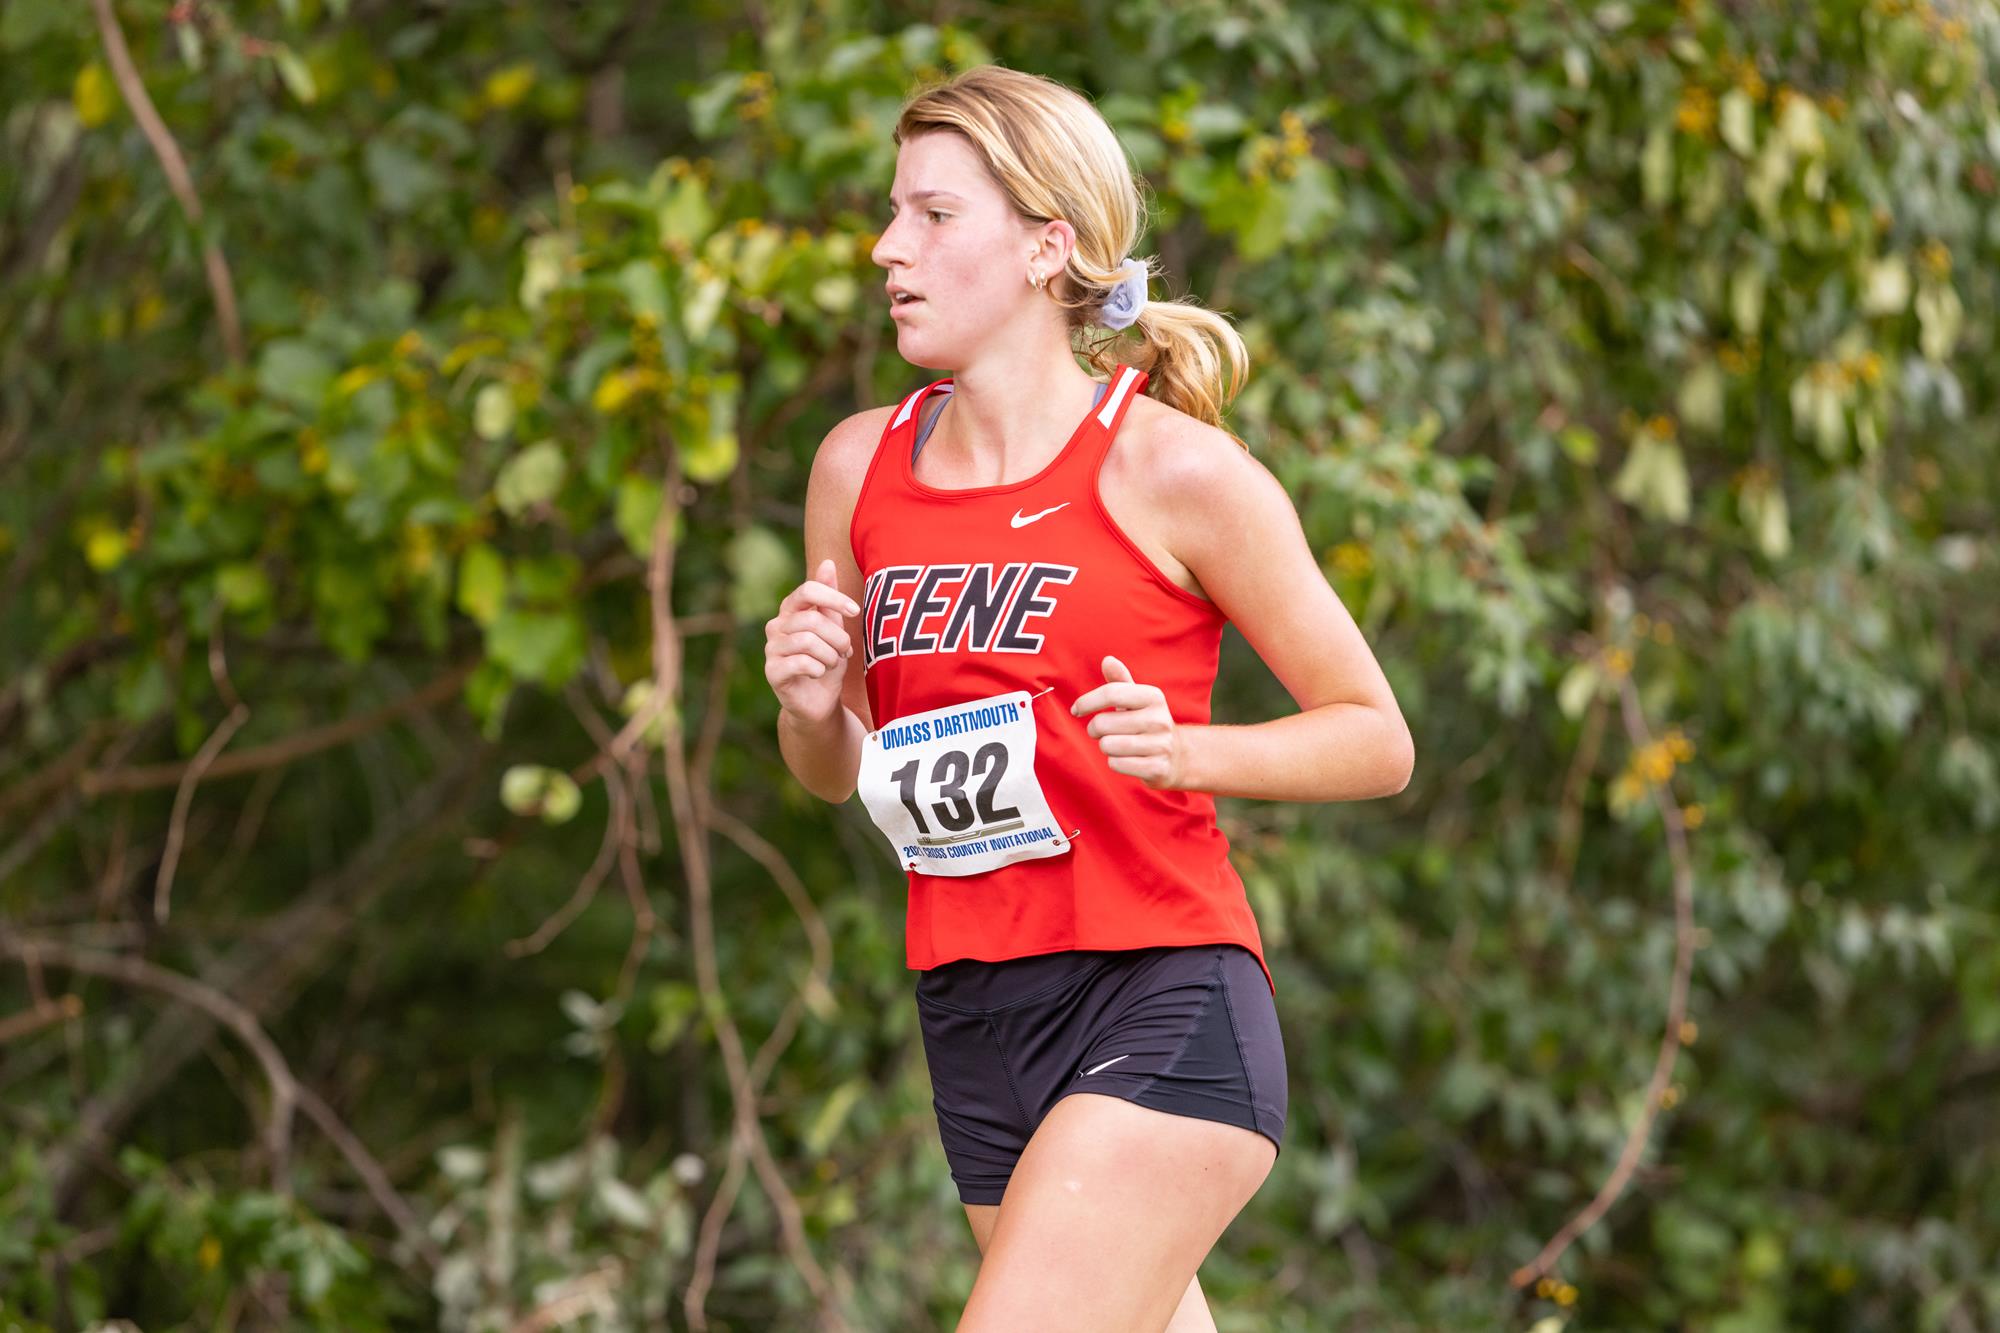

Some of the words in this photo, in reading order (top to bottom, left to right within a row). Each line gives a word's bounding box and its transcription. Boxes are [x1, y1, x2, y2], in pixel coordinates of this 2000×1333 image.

[881, 721, 931, 750] UMASS
[933, 702, 1019, 738] DARTMOUTH
[890, 741, 1021, 834] 132
[922, 846, 947, 858] CROSS
[947, 839, 989, 858] COUNTRY
[990, 827, 1056, 850] INVITATIONAL
